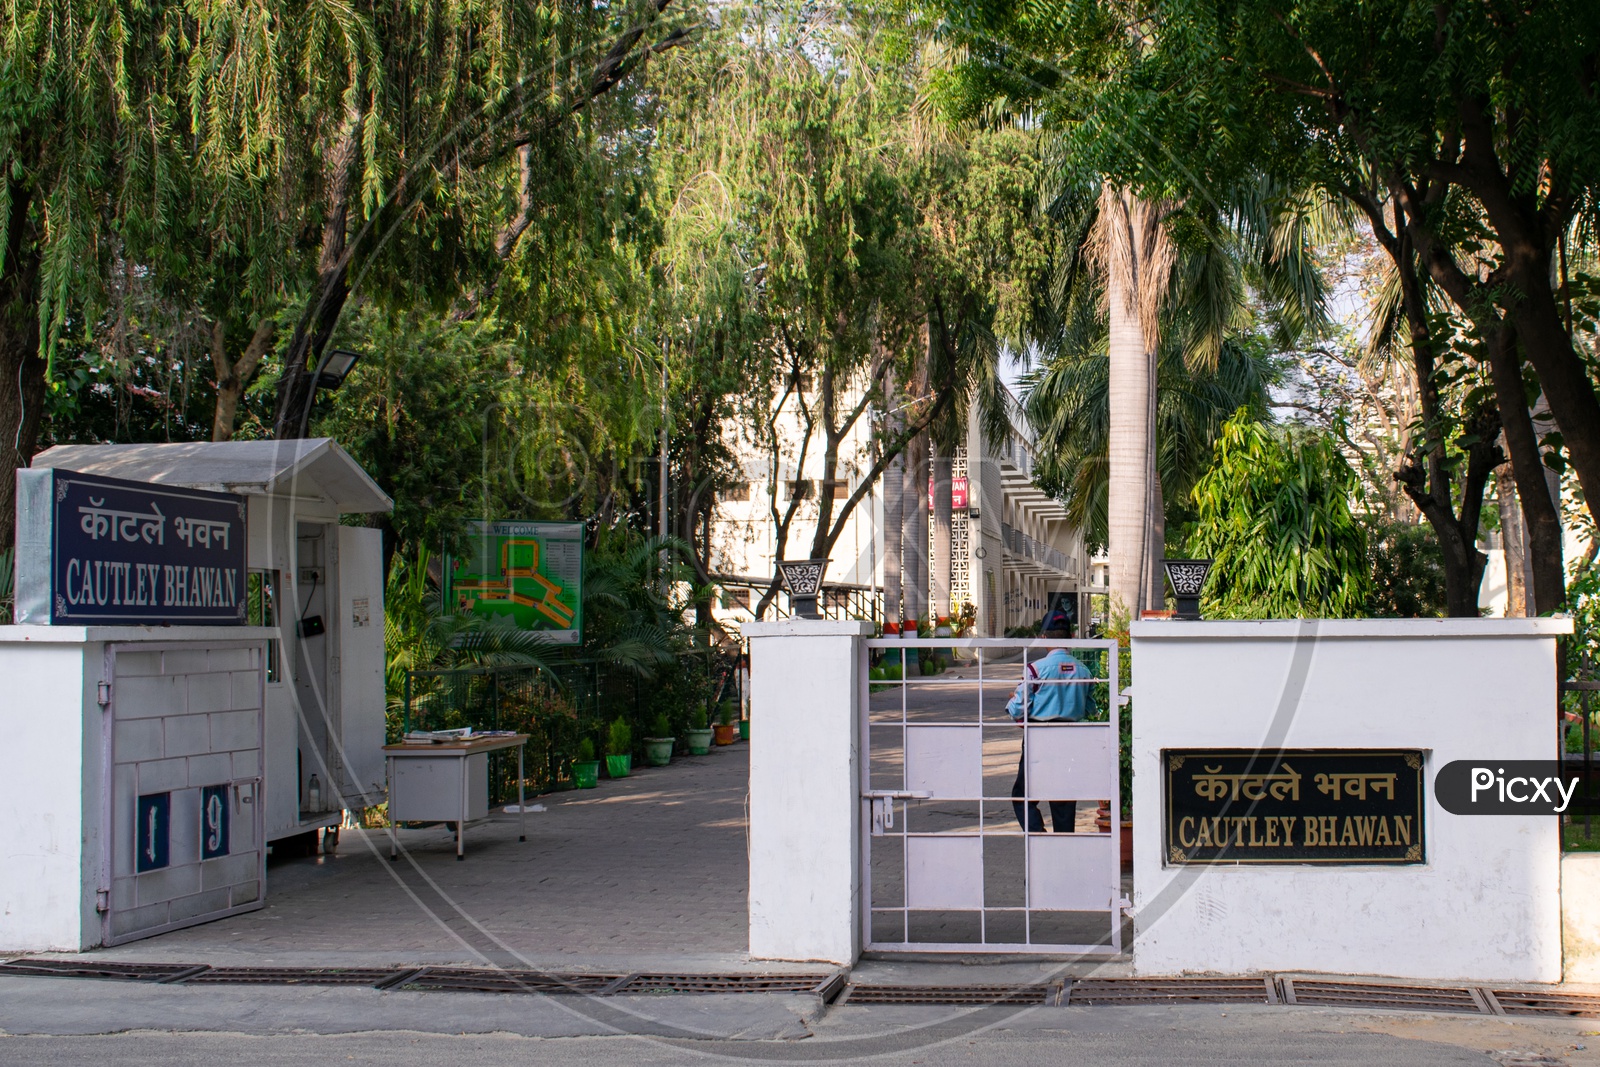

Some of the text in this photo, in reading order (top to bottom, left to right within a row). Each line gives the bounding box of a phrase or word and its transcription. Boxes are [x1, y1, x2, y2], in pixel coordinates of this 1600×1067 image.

[174, 517, 231, 551] भवन
[493, 525, 539, 536] WELCOME
[66, 557, 237, 608] CAUTLEY BHAWAN
[1314, 772, 1397, 801] भवन
[1179, 815, 1412, 848] CAUTLEY BHAWAN
